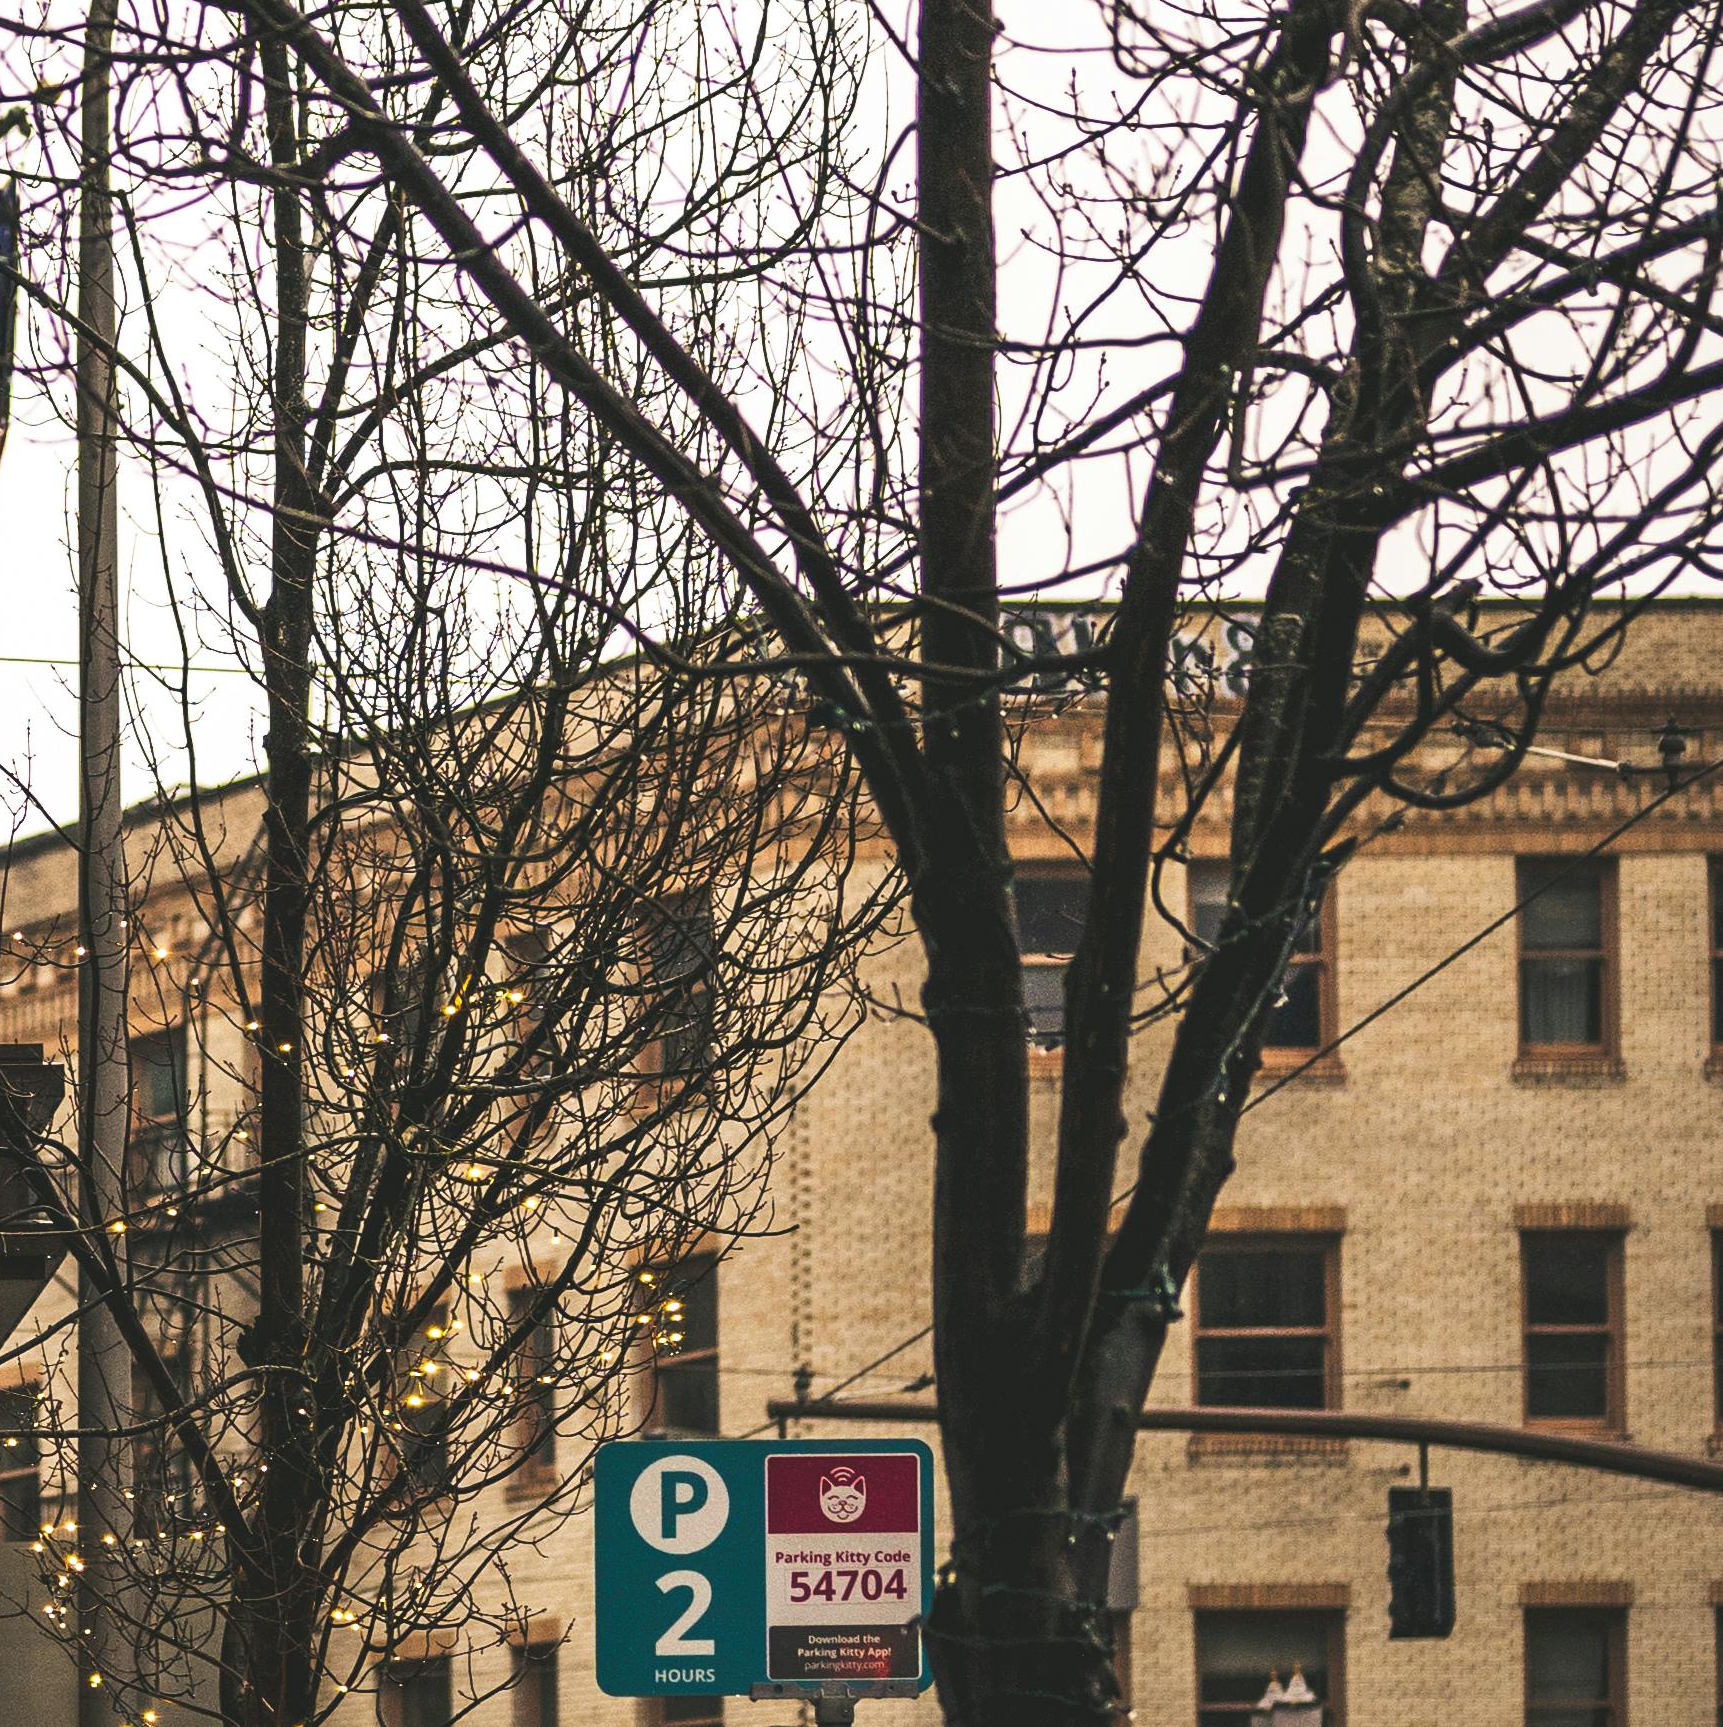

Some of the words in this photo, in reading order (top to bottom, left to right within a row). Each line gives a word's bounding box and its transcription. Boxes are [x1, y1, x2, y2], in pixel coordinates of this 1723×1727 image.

[659, 1469, 709, 1540] P
[775, 1551, 832, 1567] Parking
[836, 1550, 871, 1566] Kitty
[874, 1549, 911, 1563] Code
[790, 1568, 908, 1603] 54704
[654, 1569, 716, 1657] 2
[808, 1634, 860, 1645] Download
[862, 1633, 881, 1644] the
[797, 1648, 837, 1659] Parking
[839, 1647, 865, 1659] Kitty
[867, 1646, 892, 1659] App!
[804, 1659, 885, 1672] parkingkitty.com
[654, 1669, 716, 1684] HOURS
